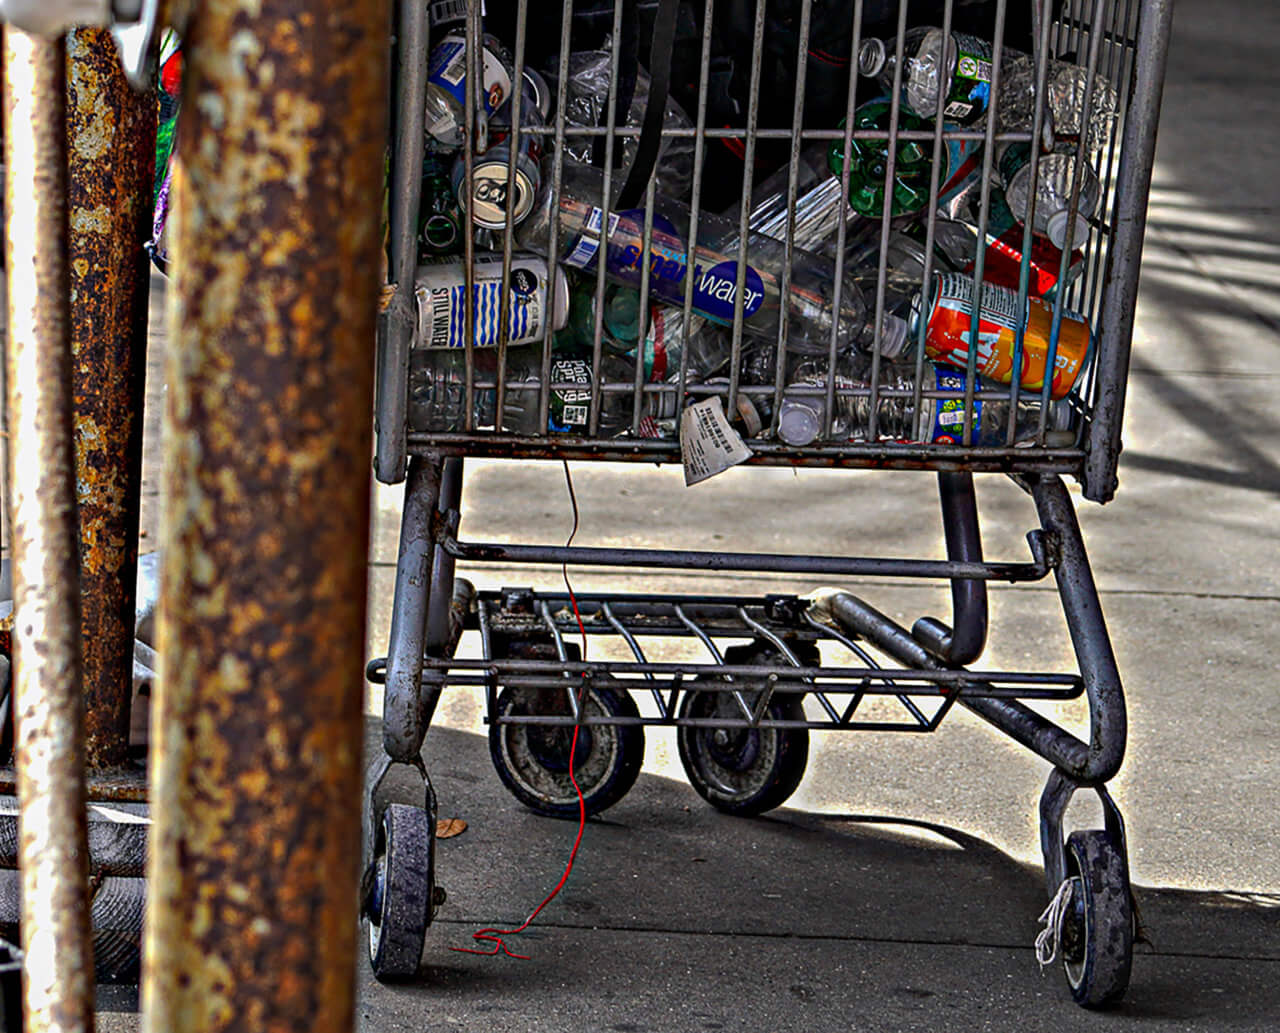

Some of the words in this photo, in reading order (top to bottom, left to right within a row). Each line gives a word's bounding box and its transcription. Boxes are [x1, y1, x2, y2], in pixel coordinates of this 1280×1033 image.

[431, 287, 449, 316] STILL
[431, 314, 449, 347] WATER
[556, 360, 577, 402] Sprg
[571, 360, 592, 401] Polad
